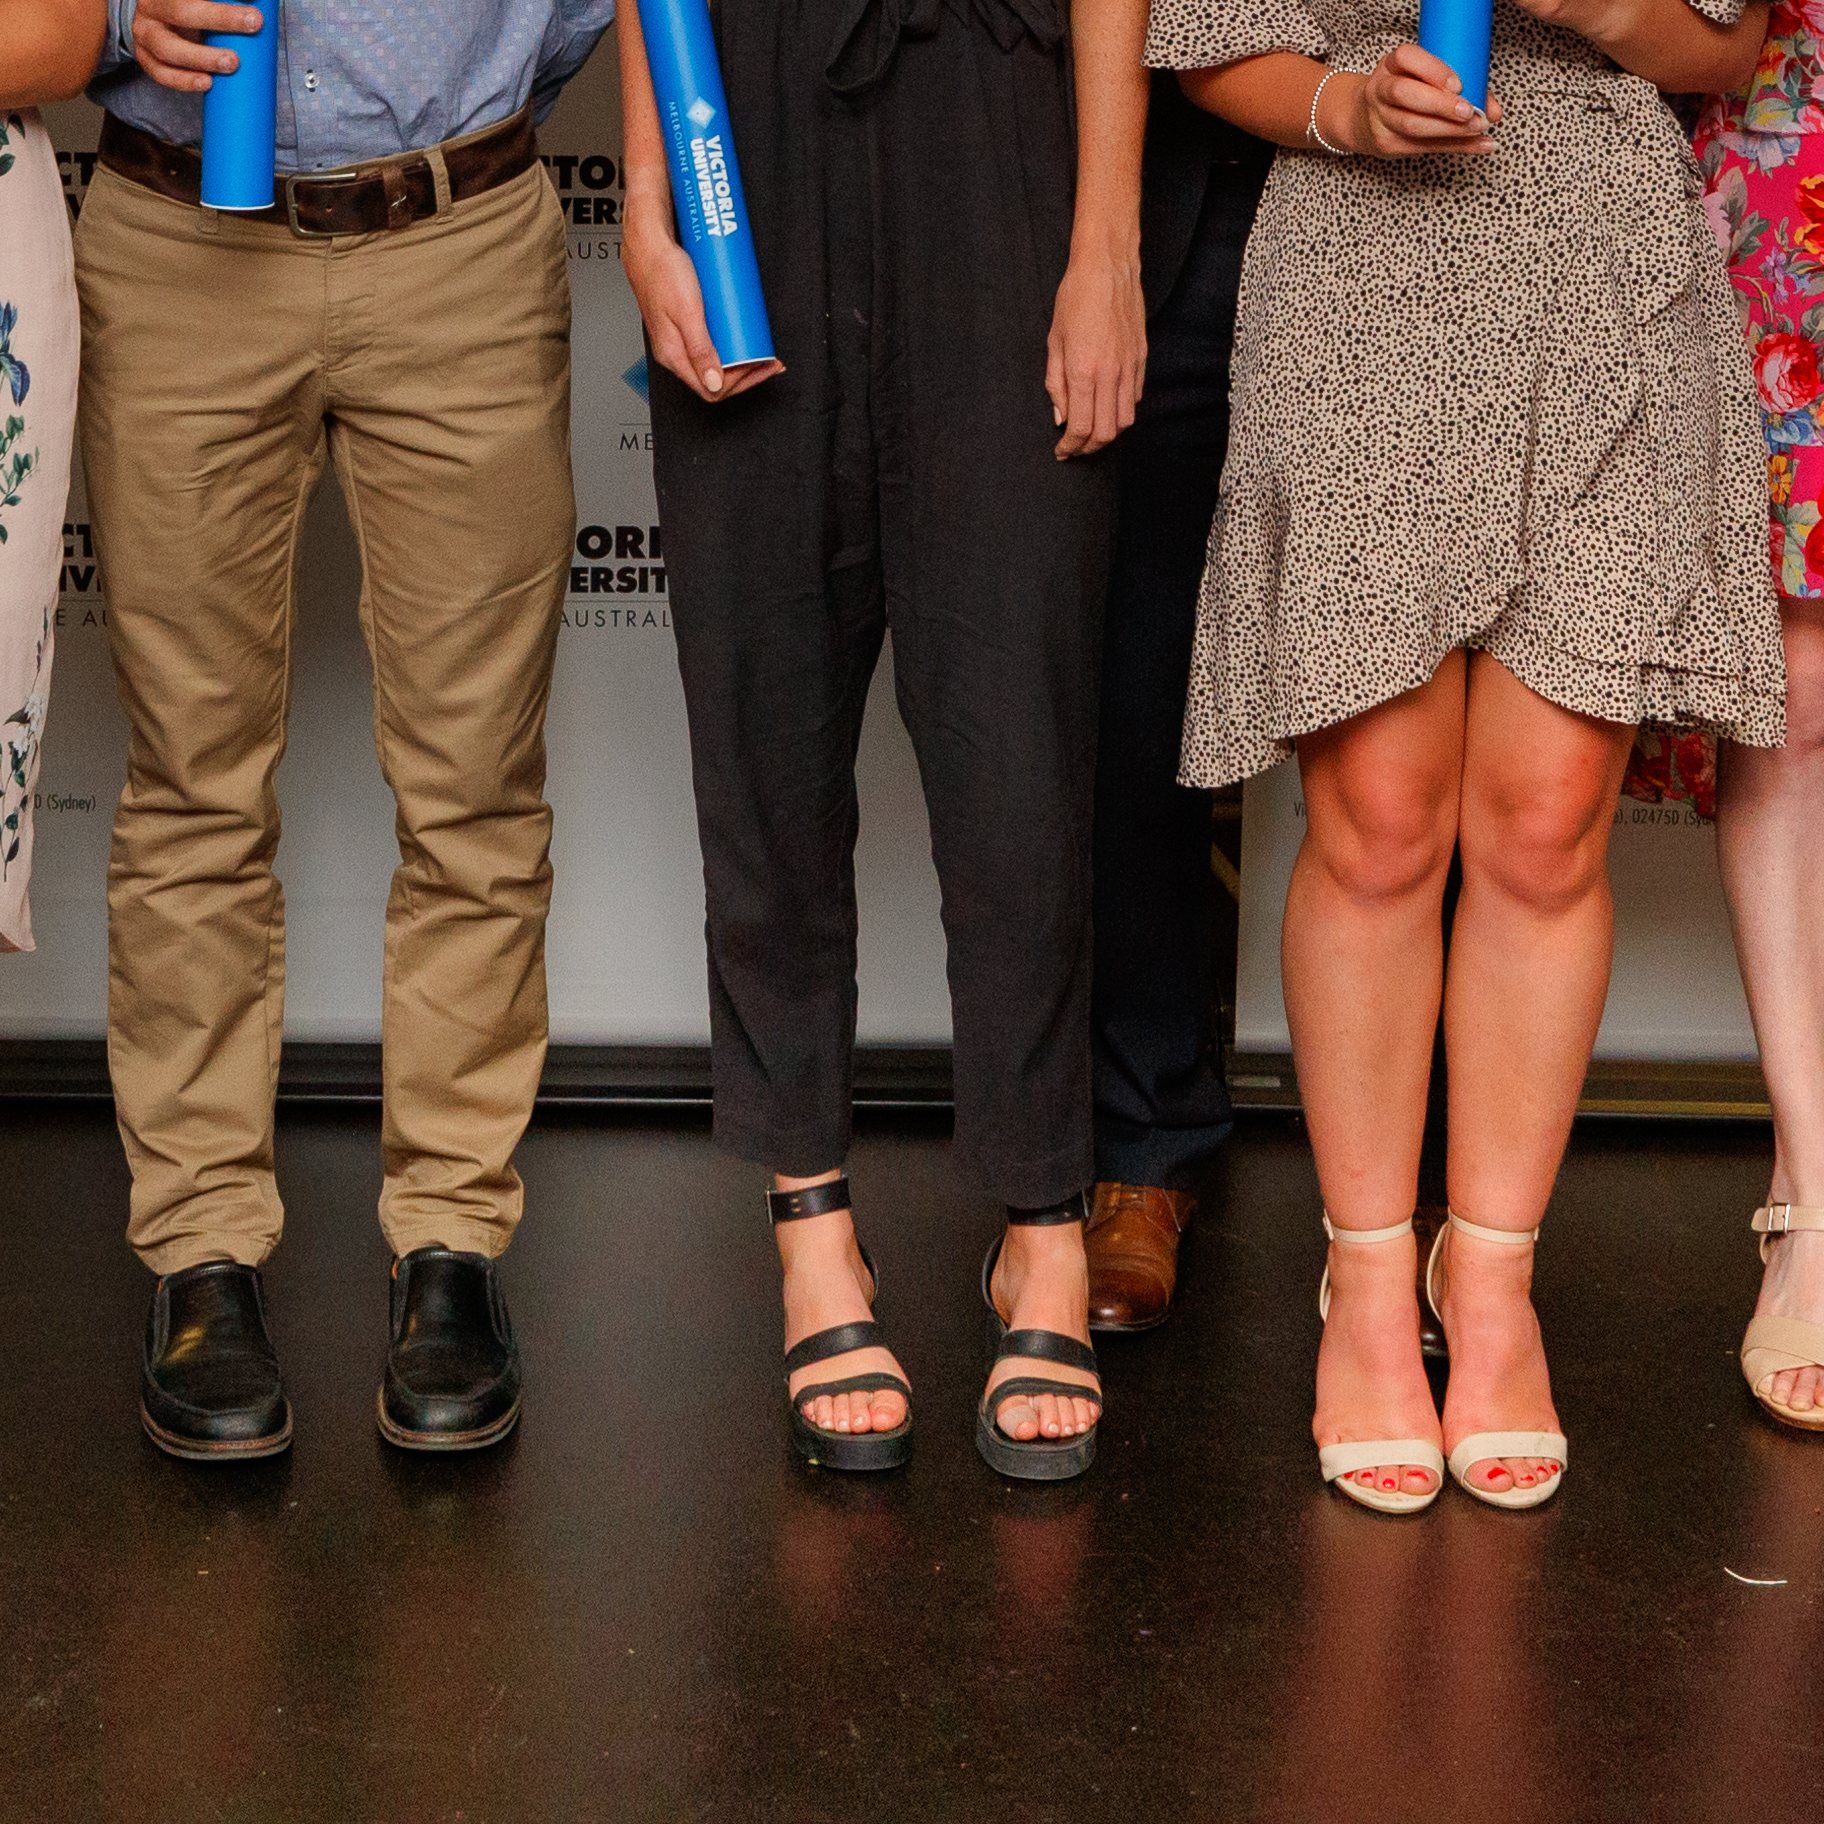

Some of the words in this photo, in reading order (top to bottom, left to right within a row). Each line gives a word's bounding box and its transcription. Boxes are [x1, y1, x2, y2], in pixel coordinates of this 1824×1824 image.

[668, 101, 689, 176] MELBOURNE
[683, 179, 702, 243] AUSTRALIA
[690, 138, 722, 238] UNIVERSITY
[706, 134, 738, 237] VICTORIA
[46, 793, 96, 813] (Sydney)
